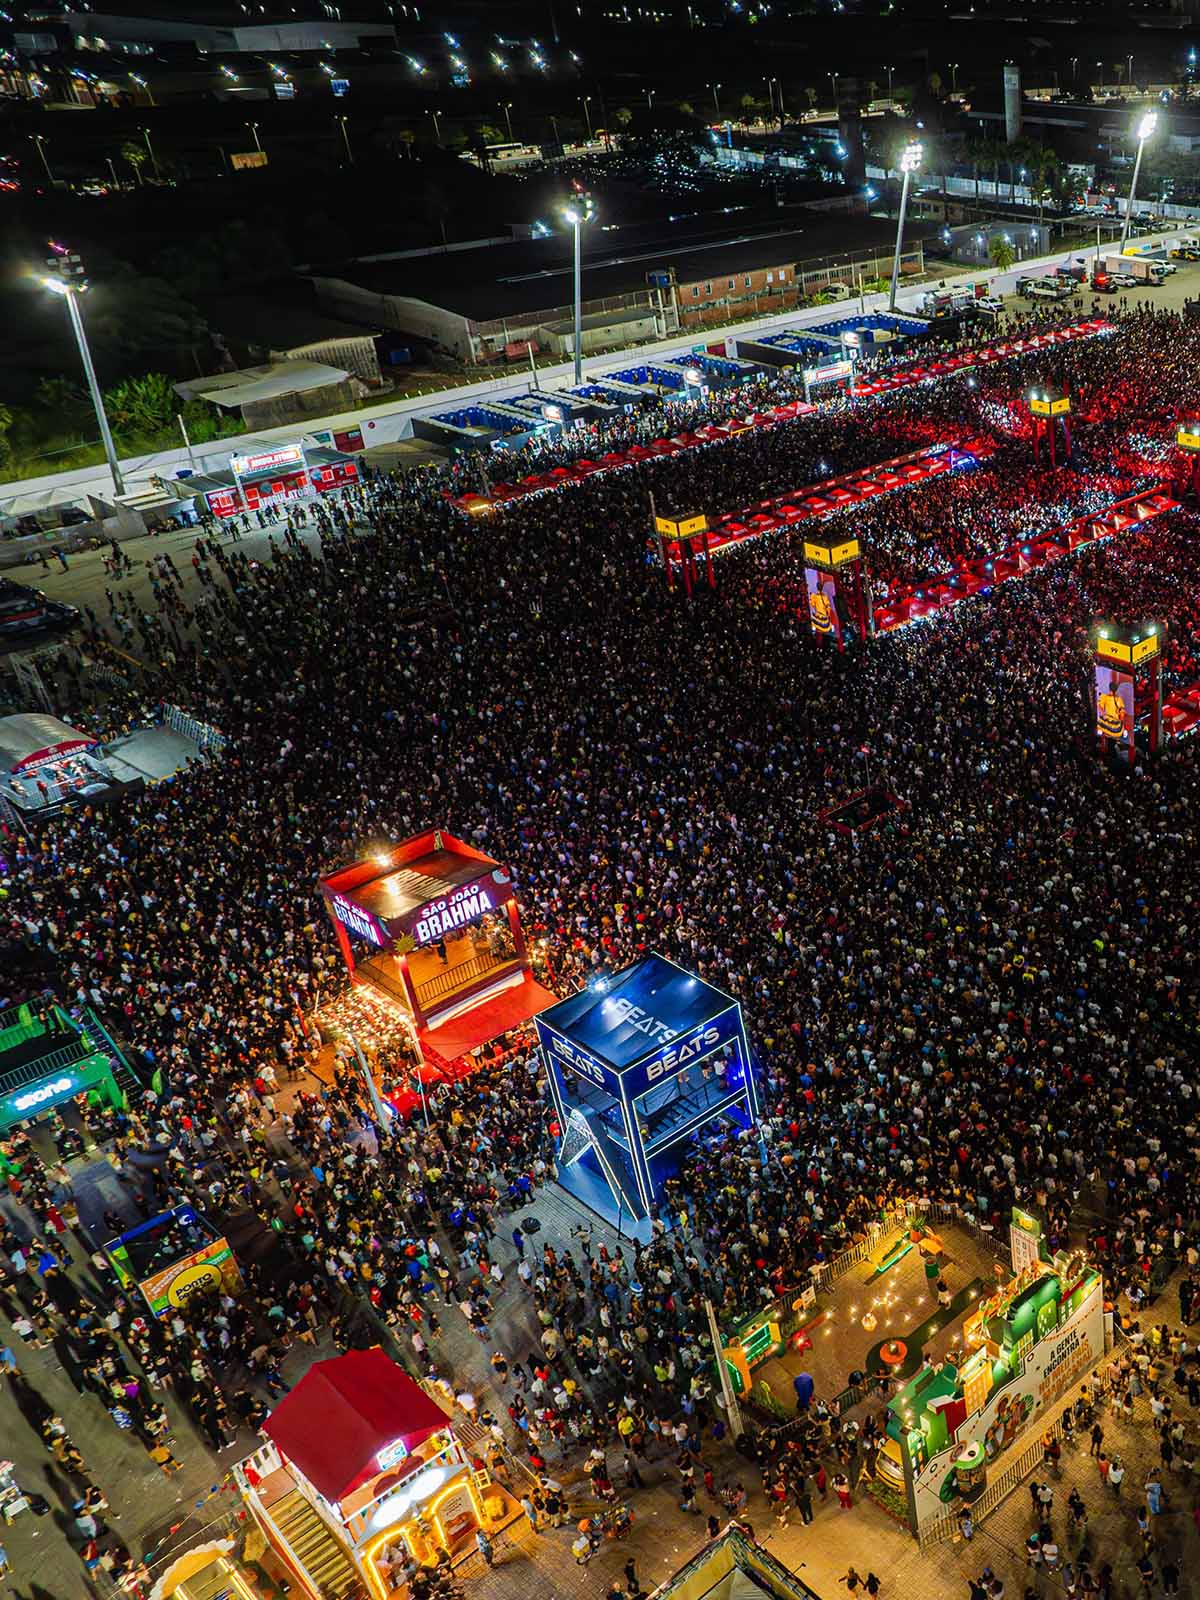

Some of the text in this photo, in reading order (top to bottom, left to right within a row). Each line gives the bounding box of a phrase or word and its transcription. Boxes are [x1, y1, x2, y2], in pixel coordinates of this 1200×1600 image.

[333, 901, 381, 946] BRAHMA
[415, 890, 492, 943] BRAHMA
[421, 884, 479, 918] SÃO JOÃO
[616, 999, 678, 1044] BEATS
[552, 1036, 606, 1083] BEATS
[646, 1027, 720, 1081] BEATS
[16, 1078, 72, 1110] stone
[1043, 1338, 1080, 1378] ENCONTRA
[1050, 1328, 1078, 1361] A GENTE
